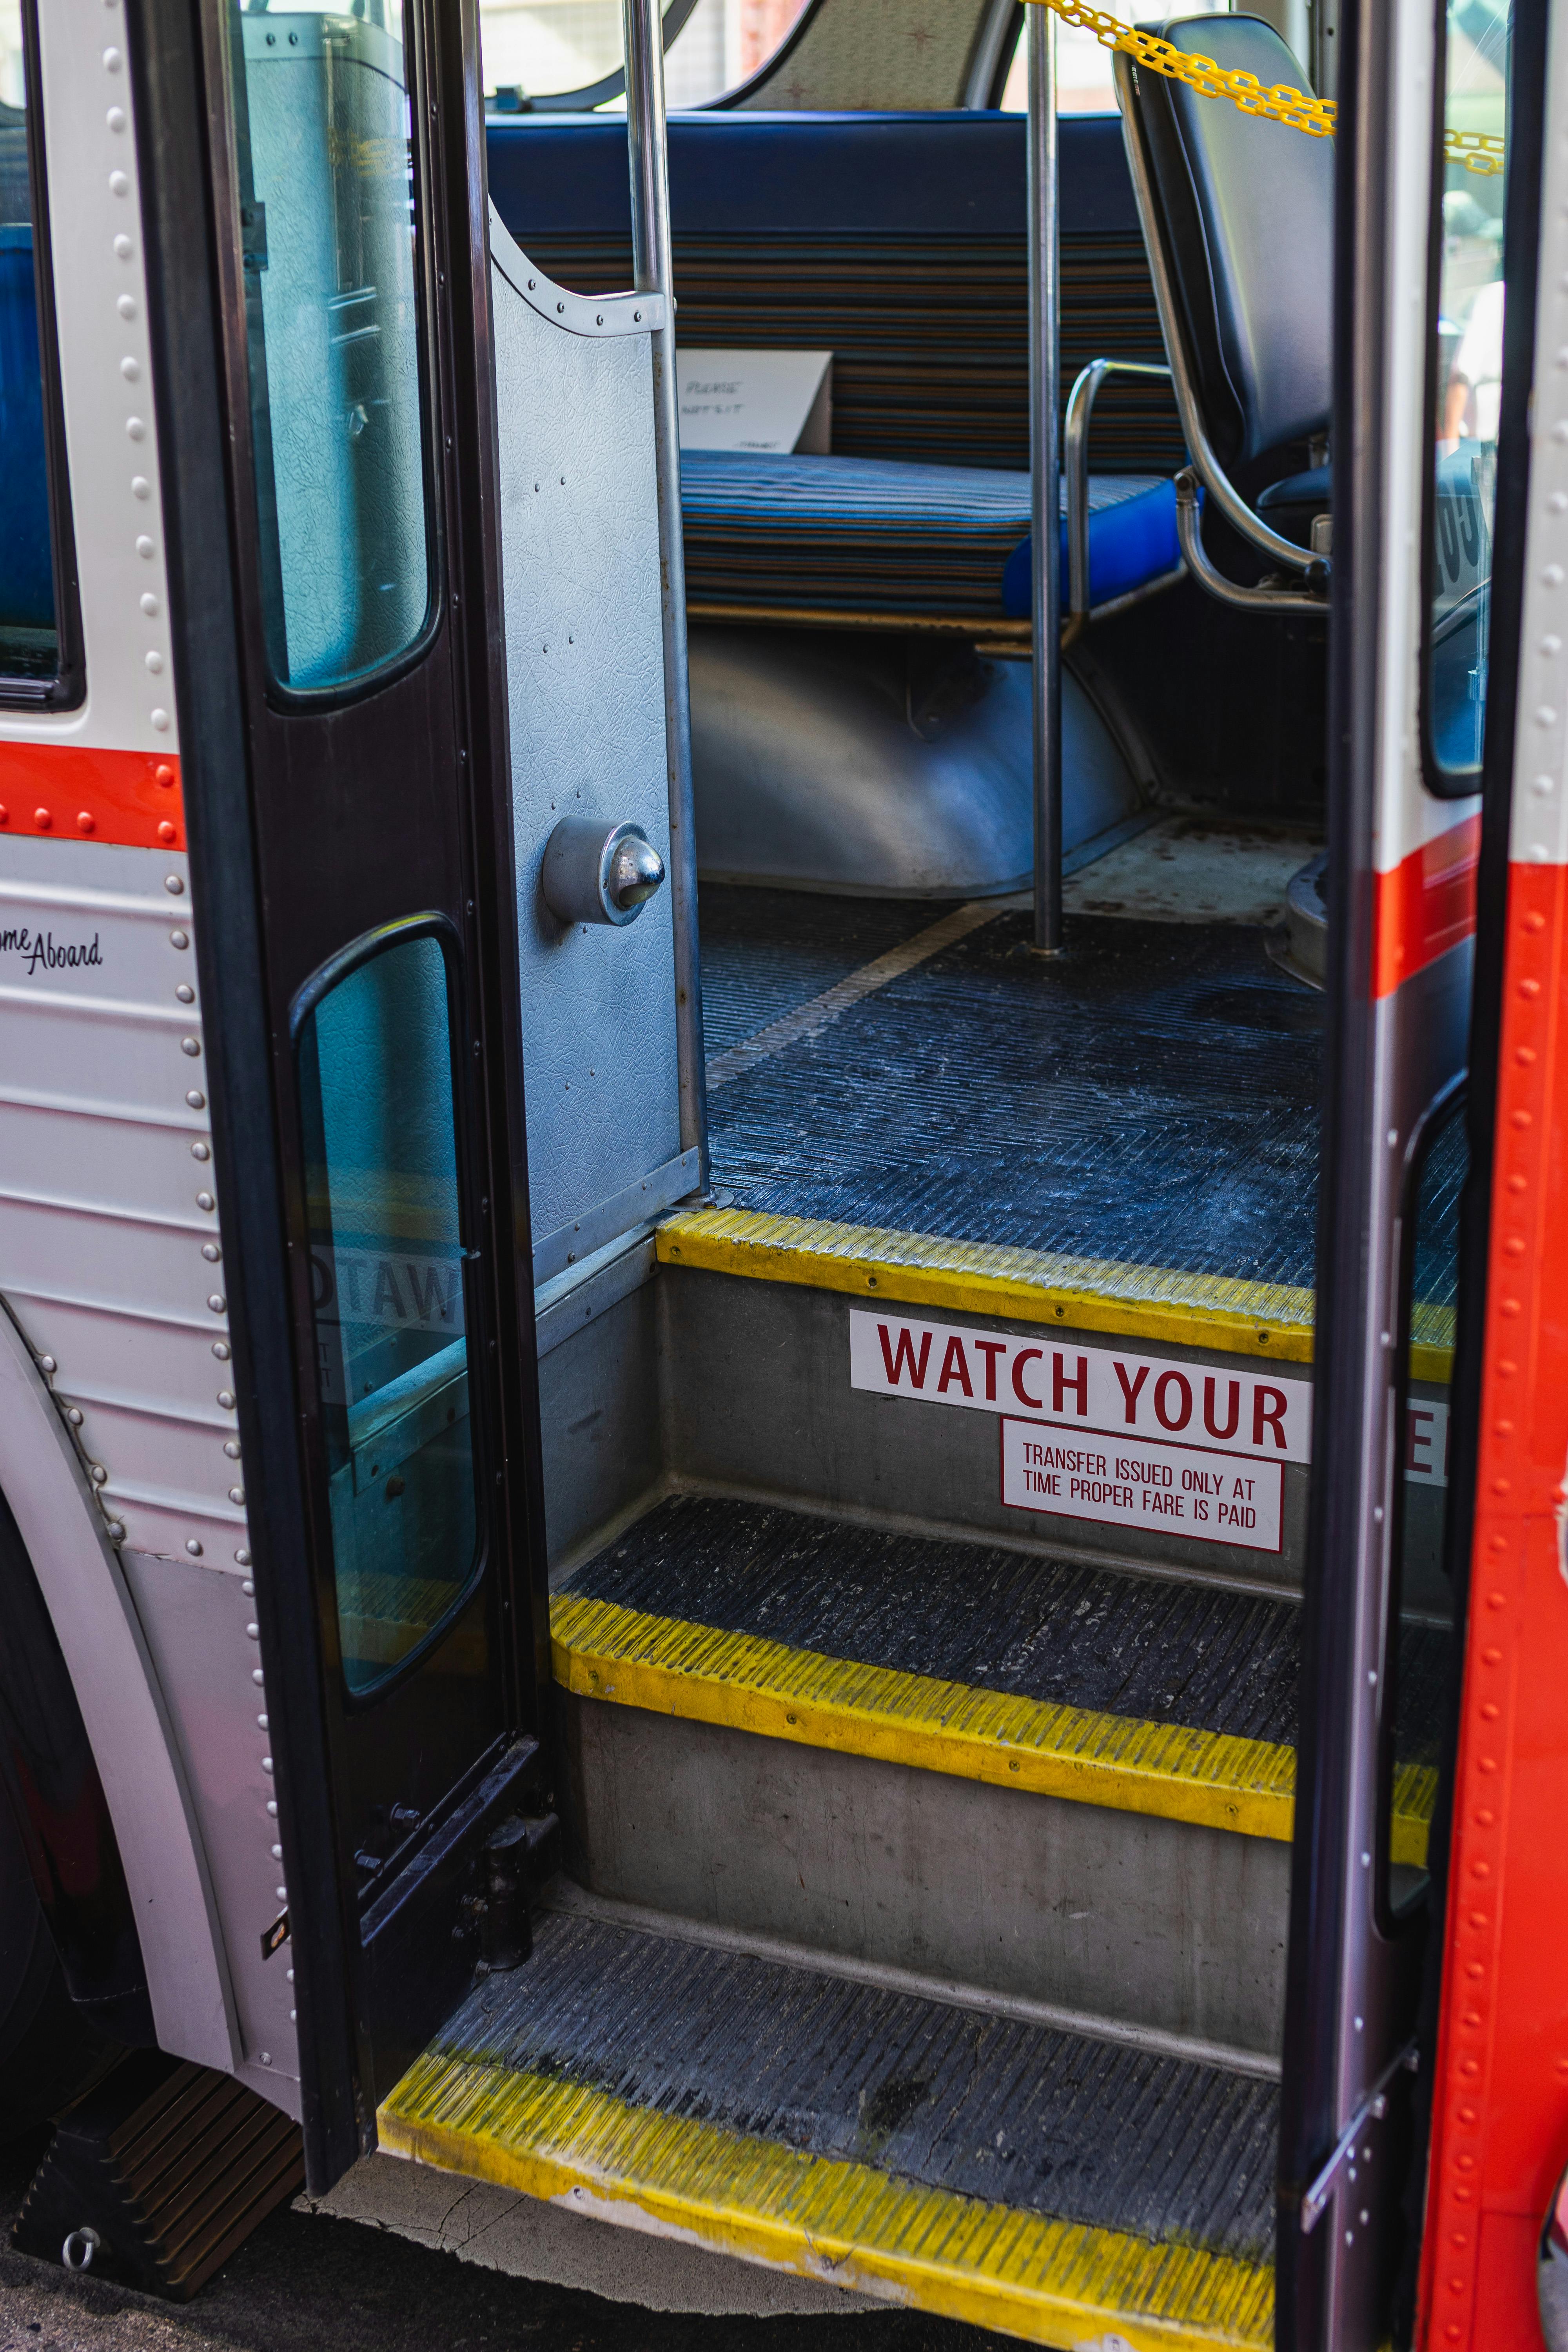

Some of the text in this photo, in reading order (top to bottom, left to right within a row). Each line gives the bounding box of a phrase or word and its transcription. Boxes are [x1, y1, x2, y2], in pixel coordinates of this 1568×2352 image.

[685, 380, 742, 395] PLEASE
[0, 928, 103, 975] me Aboard
[877, 1324, 1288, 1449] WATCH YOUR
[1022, 1442, 1255, 1501] TRANSFER ISSUED ONLY AT
[1022, 1469, 1256, 1529] TIME PROPER FARE IS PAID
